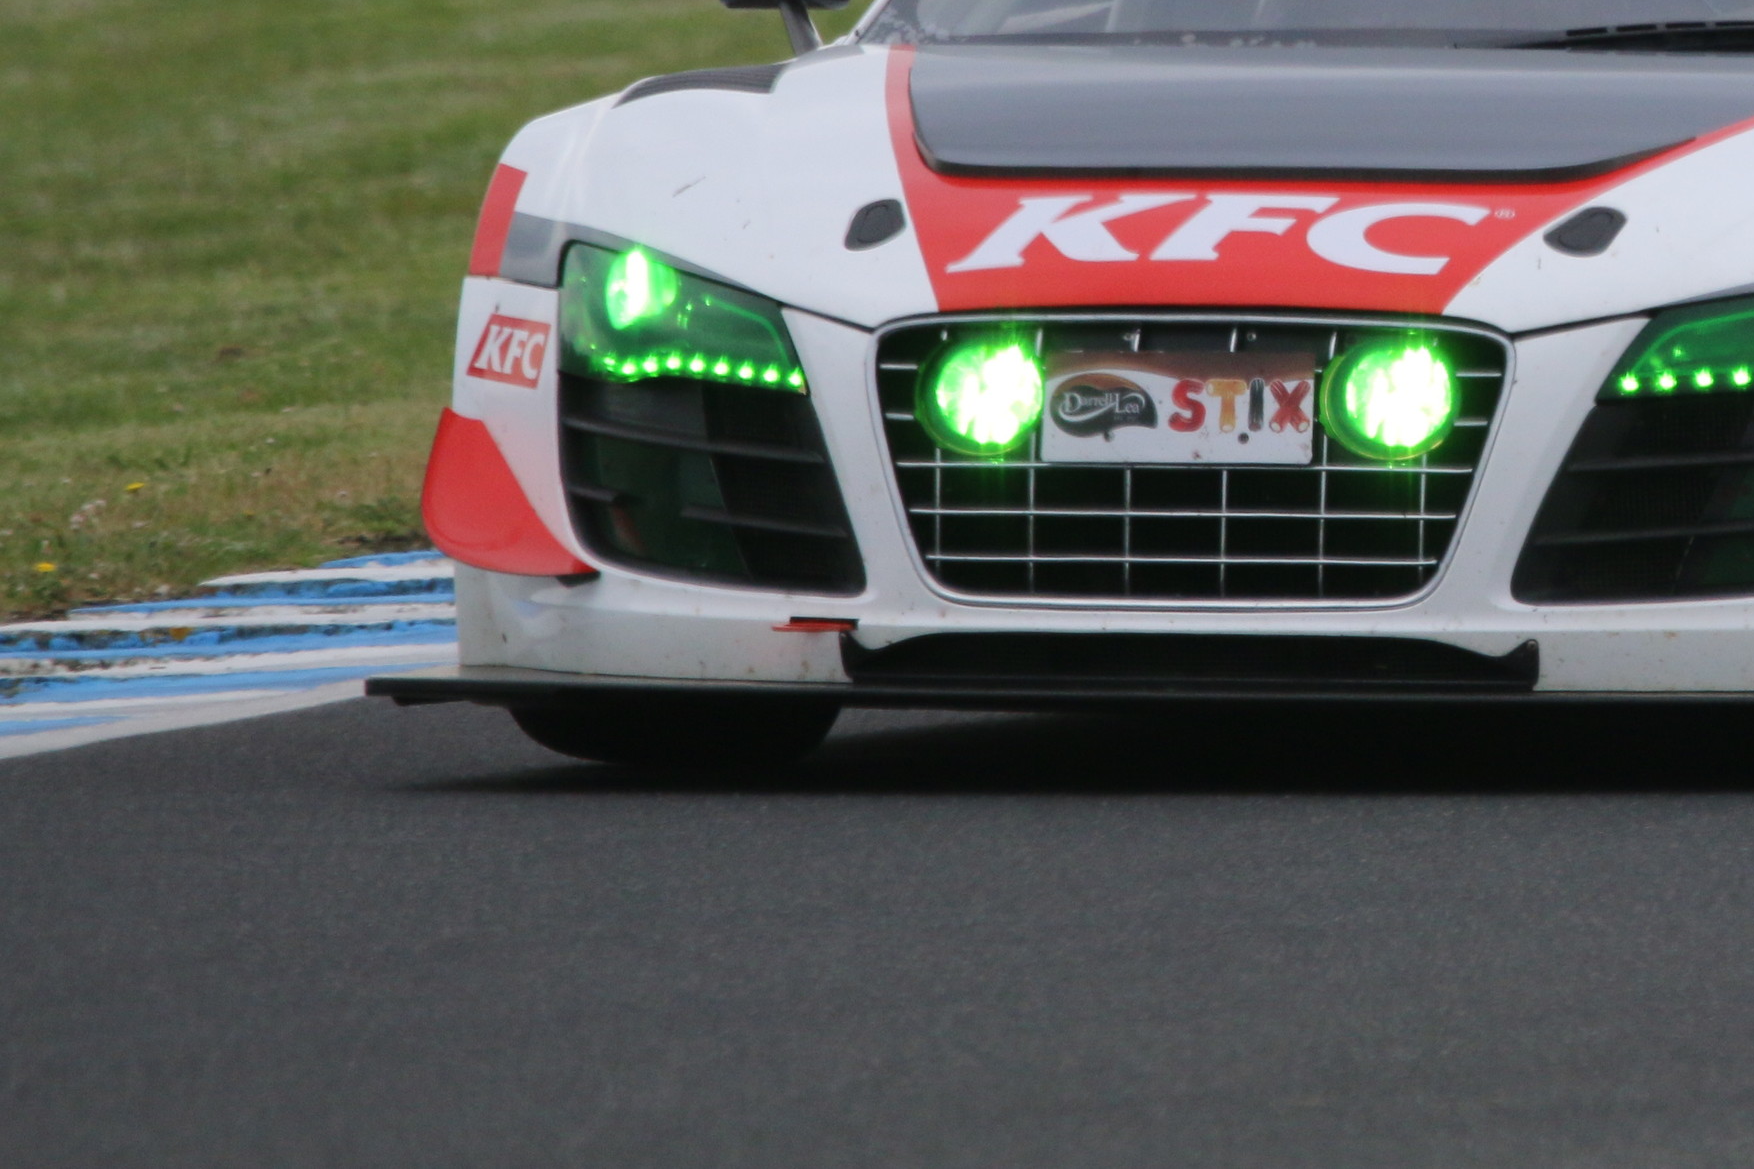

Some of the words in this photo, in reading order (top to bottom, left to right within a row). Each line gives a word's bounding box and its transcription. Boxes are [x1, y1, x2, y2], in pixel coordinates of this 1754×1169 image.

[946, 193, 1491, 275] KFC
[474, 324, 546, 380] KFC
[1062, 391, 1113, 414] Darrell
[1114, 392, 1141, 414] Lea
[1168, 379, 1311, 432] STIX
